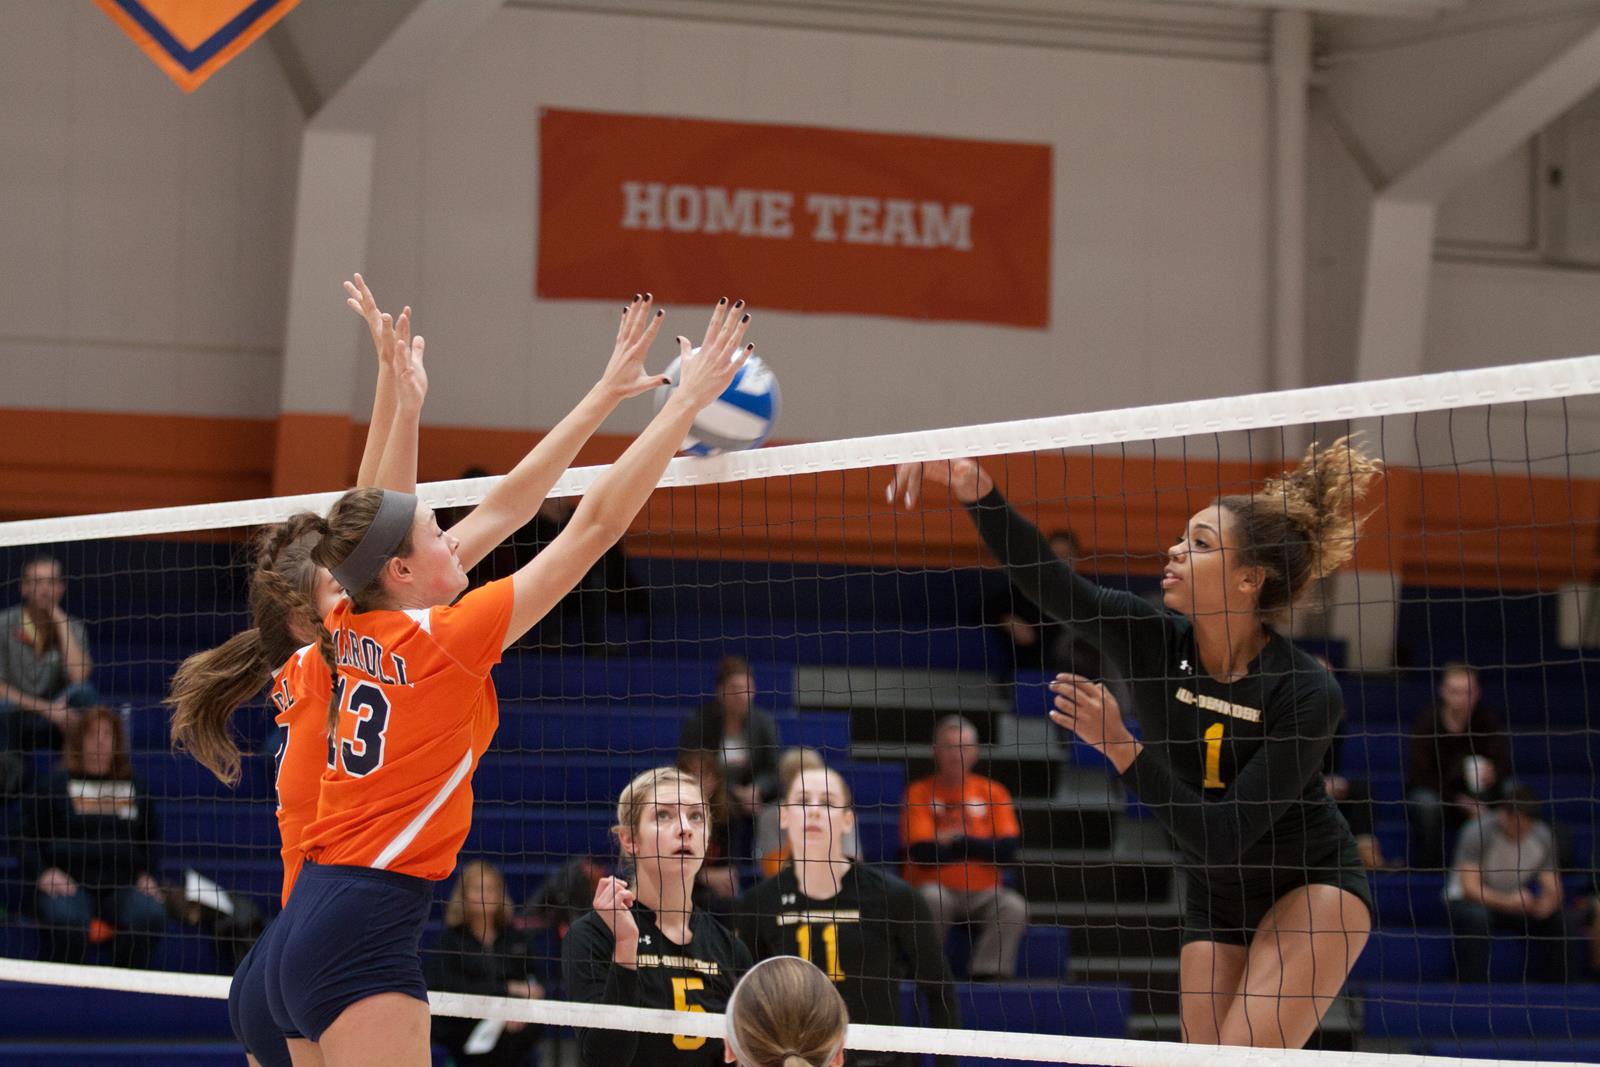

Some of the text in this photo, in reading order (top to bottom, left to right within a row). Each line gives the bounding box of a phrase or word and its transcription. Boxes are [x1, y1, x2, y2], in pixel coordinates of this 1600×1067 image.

[622, 182, 974, 250] HOME TEAM
[327, 675, 392, 778] 13
[1204, 722, 1226, 789] 1
[795, 922, 846, 982] 11
[671, 977, 706, 1050] 5
